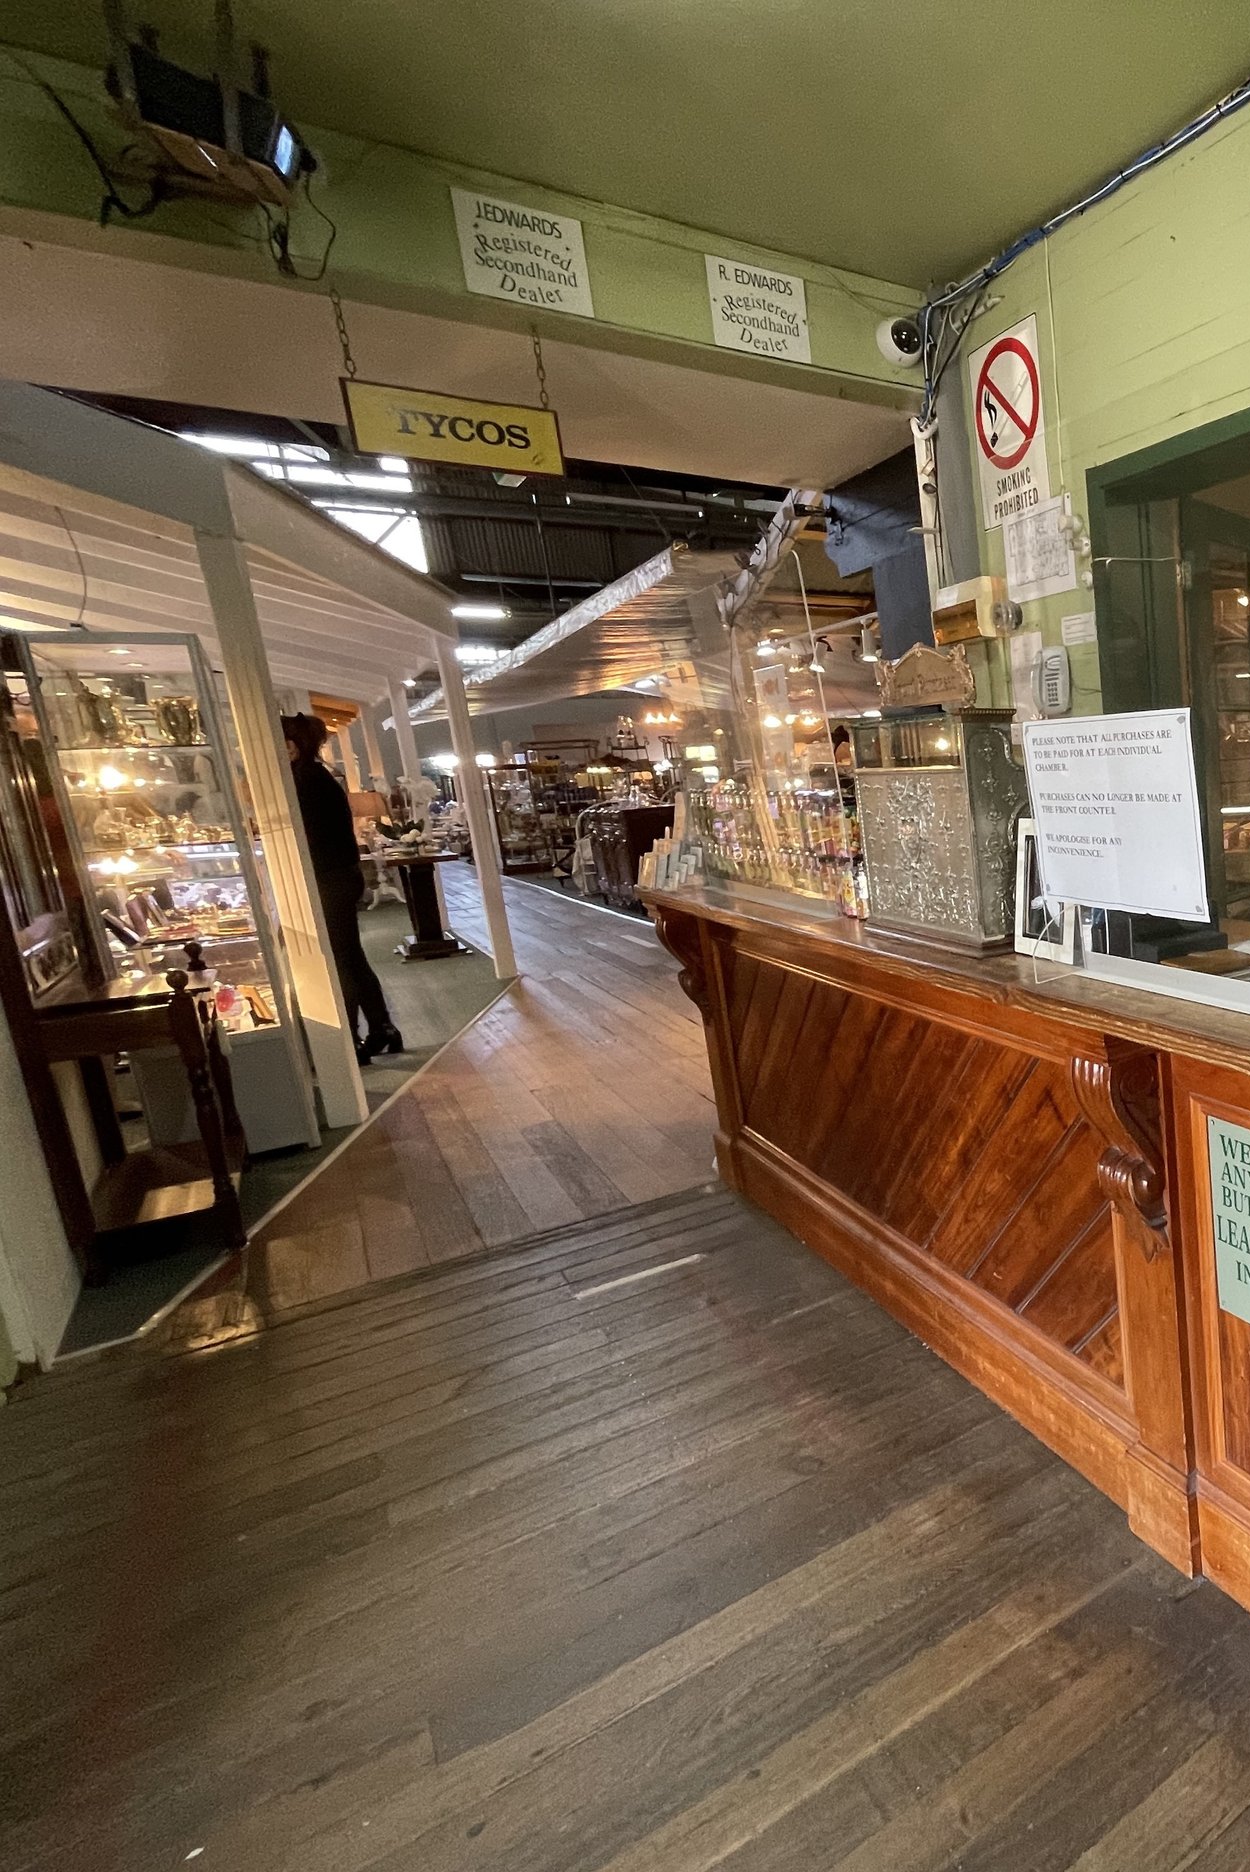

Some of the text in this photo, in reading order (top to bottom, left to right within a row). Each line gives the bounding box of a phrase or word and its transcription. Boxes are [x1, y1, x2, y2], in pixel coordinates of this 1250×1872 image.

[474, 247, 578, 287] Secondhand
[475, 233, 572, 272] Registered
[500, 274, 563, 304] Dealer
[734, 268, 793, 296] EDWARDS
[721, 306, 800, 337] Secondhand
[724, 292, 797, 324] Registered
[740, 327, 788, 352] Dealer
[393, 408, 531, 449] TYCOS
[996, 466, 1031, 497] SMOKING
[994, 487, 1039, 520] PROHIBITED
[1032, 736, 1056, 746] PLEASE
[1056, 736, 1076, 745] NOTE
[1076, 734, 1098, 744] THAT
[1113, 730, 1155, 742] PURCHASES
[1156, 730, 1173, 739] ARE
[1034, 750, 1042, 759] TO
[1044, 750, 1052, 758] BE
[1053, 750, 1069, 758] PAID
[1070, 748, 1084, 758] FOR
[1086, 748, 1096, 757] AT
[1116, 745, 1162, 756] INDIVIDUAL
[1039, 792, 1182, 803] PURCHASES CAN NO LONGER BE MADE AT
[1042, 805, 1054, 814] THE
[1055, 806, 1078, 814] FRONT
[1056, 834, 1091, 844] APOLOGISE
[1092, 836, 1108, 845] FOR
